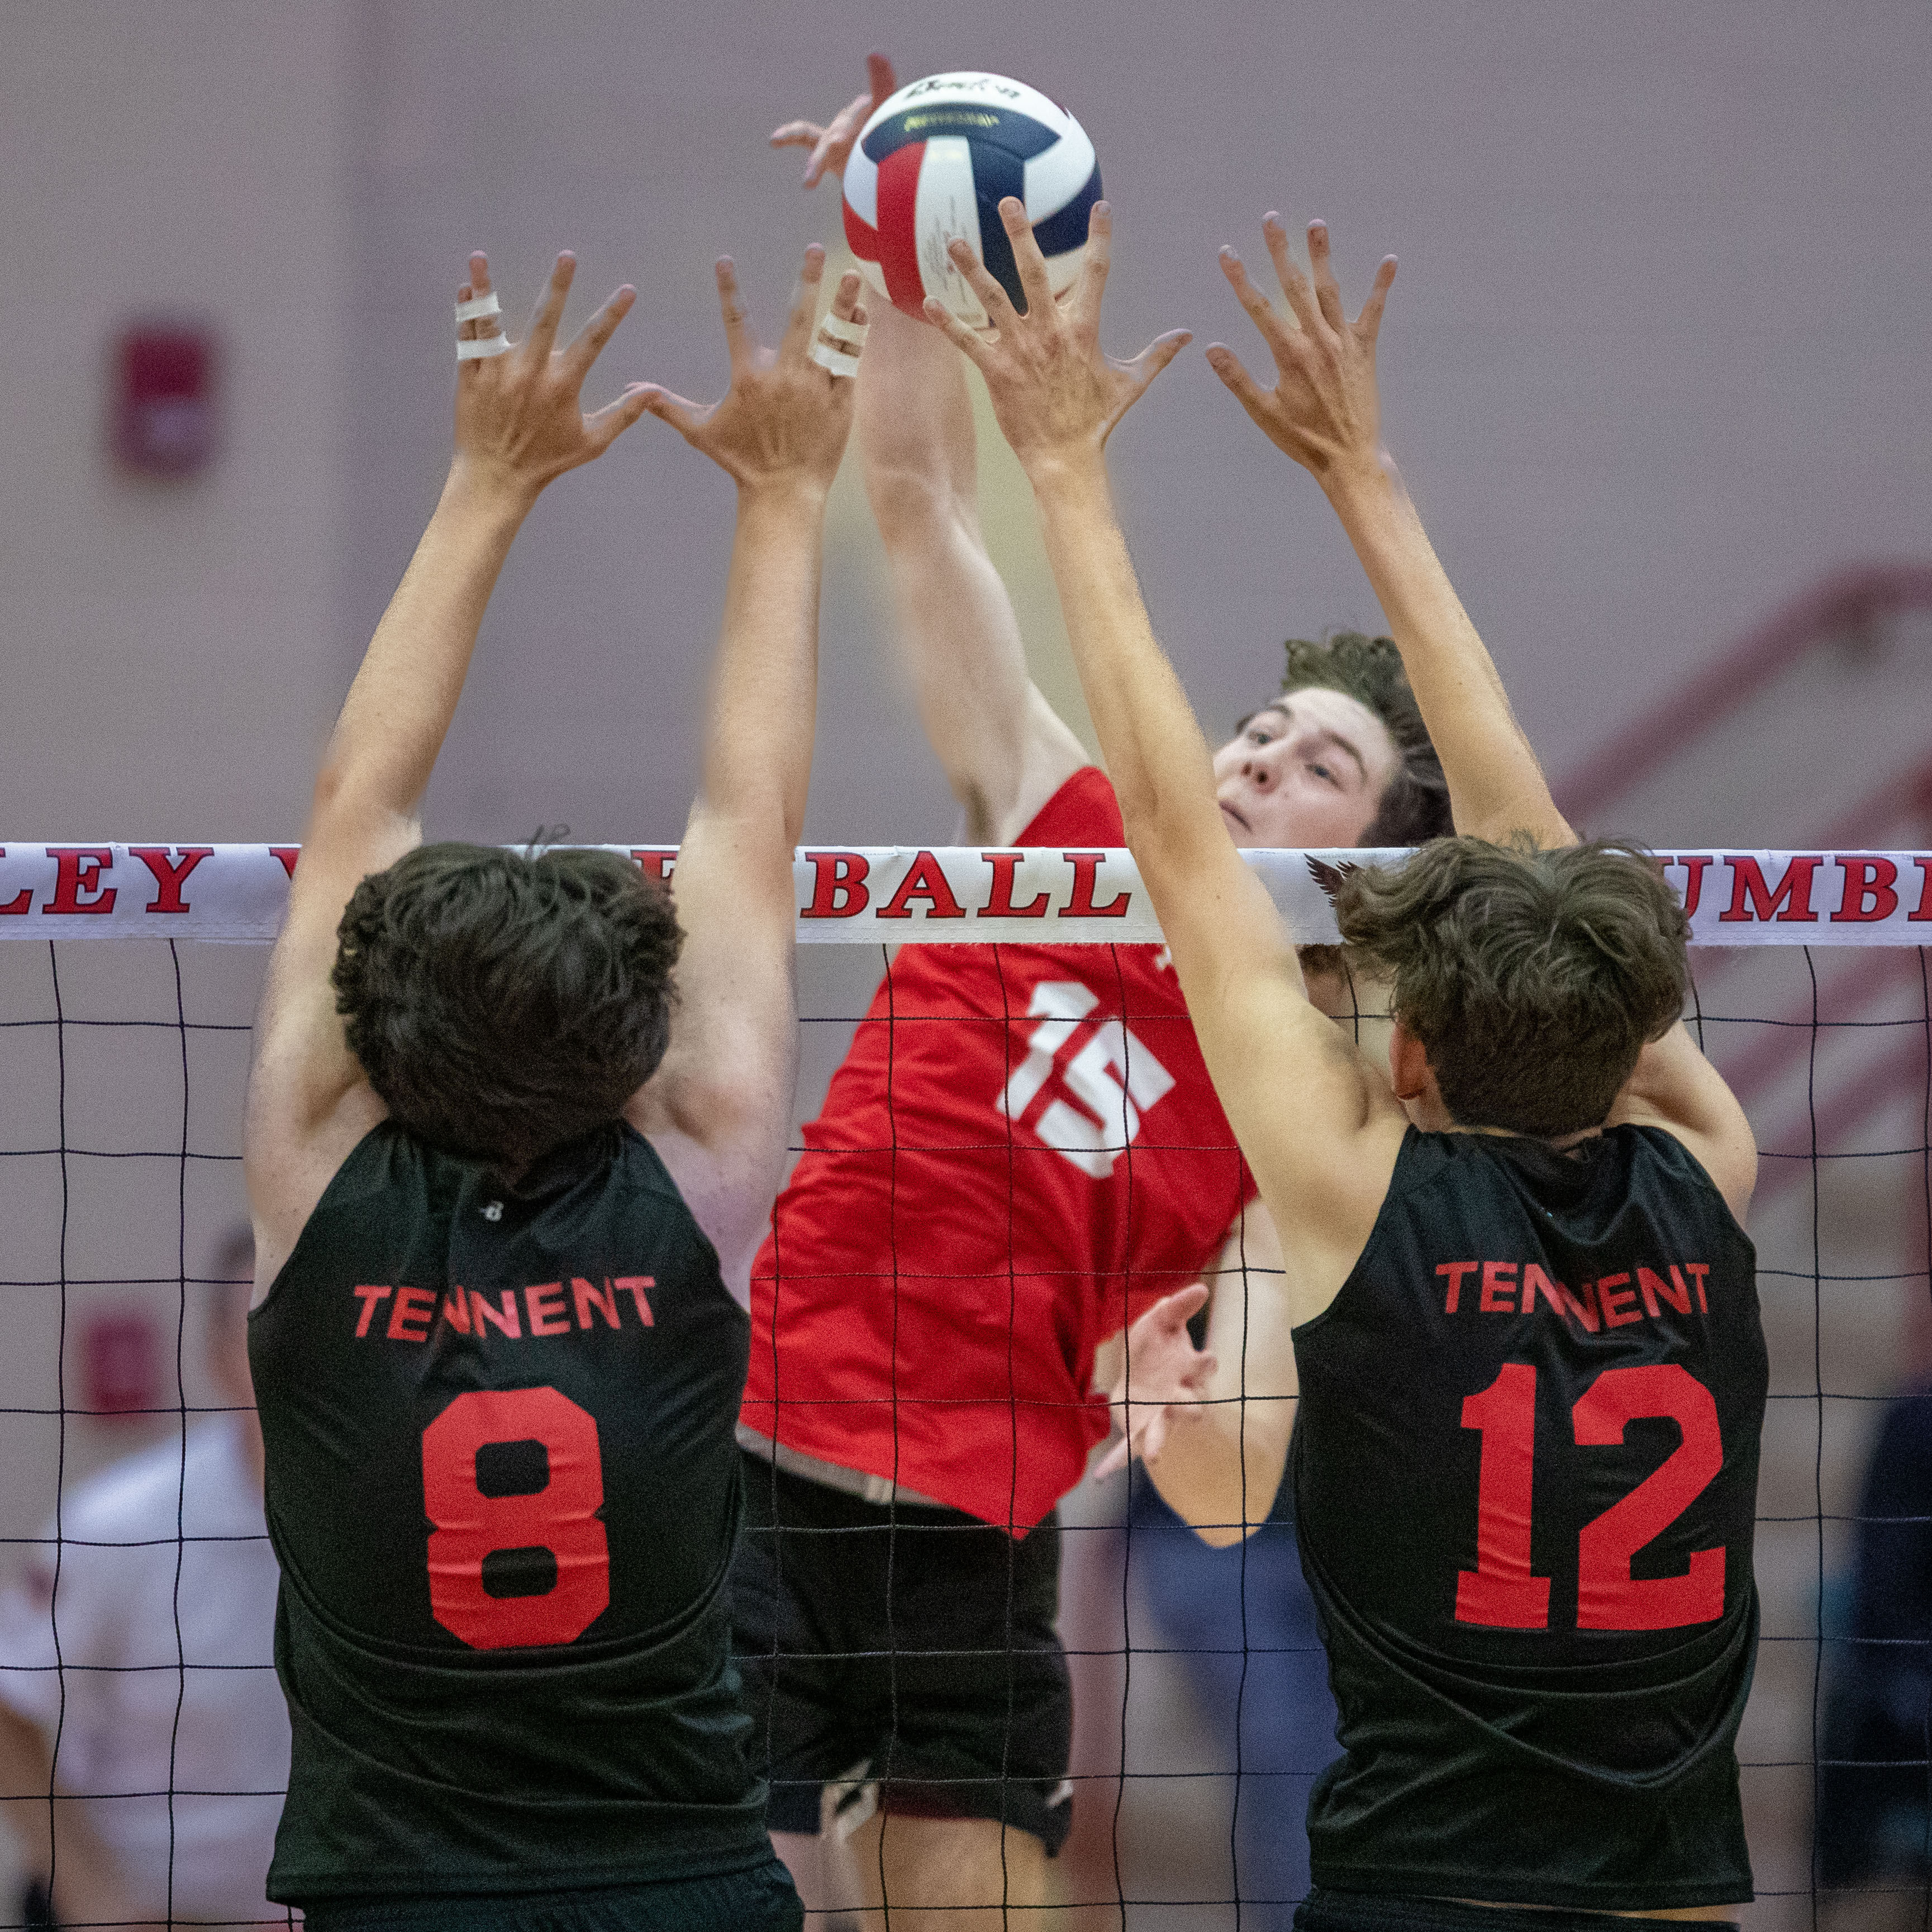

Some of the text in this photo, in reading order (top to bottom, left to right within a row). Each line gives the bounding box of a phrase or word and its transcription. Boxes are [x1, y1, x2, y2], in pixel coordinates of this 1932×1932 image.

[995, 981, 1177, 1179] 15
[354, 1276, 656, 1342] TENNENT
[1436, 1260, 1710, 1333] TENNENT
[422, 1386, 610, 1650] 8
[1455, 1362, 1726, 1631] 12
